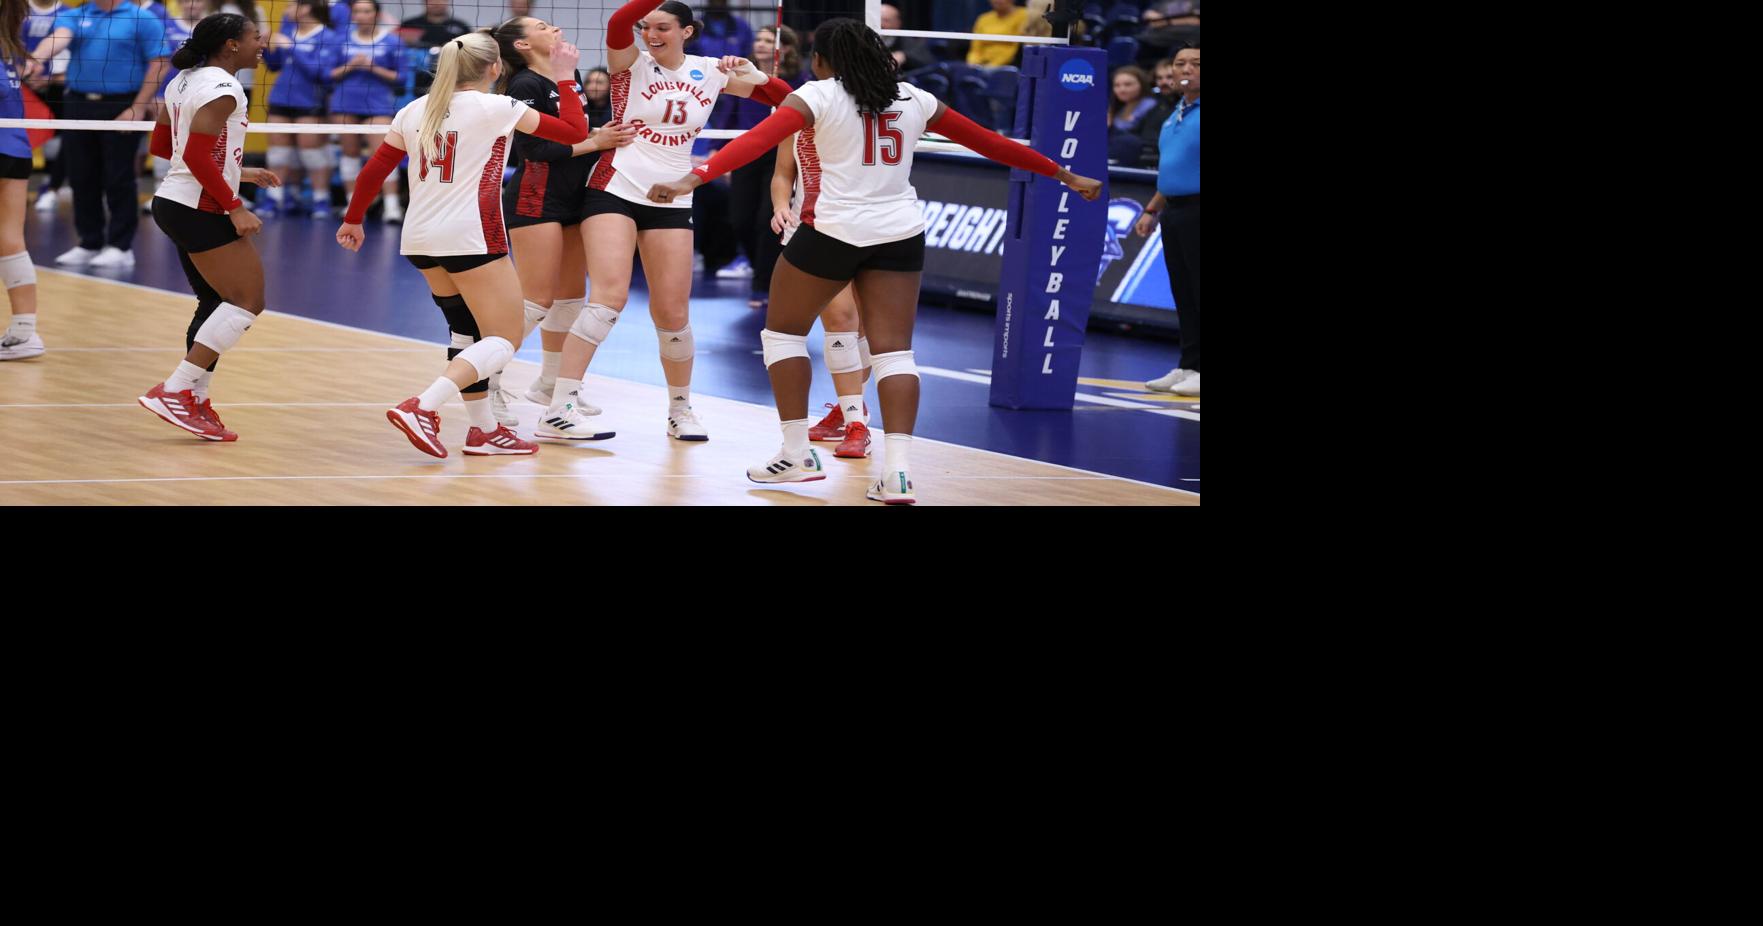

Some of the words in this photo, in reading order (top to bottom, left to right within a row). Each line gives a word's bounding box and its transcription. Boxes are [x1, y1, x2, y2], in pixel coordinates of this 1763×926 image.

[1061, 73, 1093, 84] NCAA
[641, 81, 712, 107] LOUISVILLE
[661, 99, 688, 125] 13
[861, 110, 904, 166] 15
[1005, 292, 1013, 322] sports
